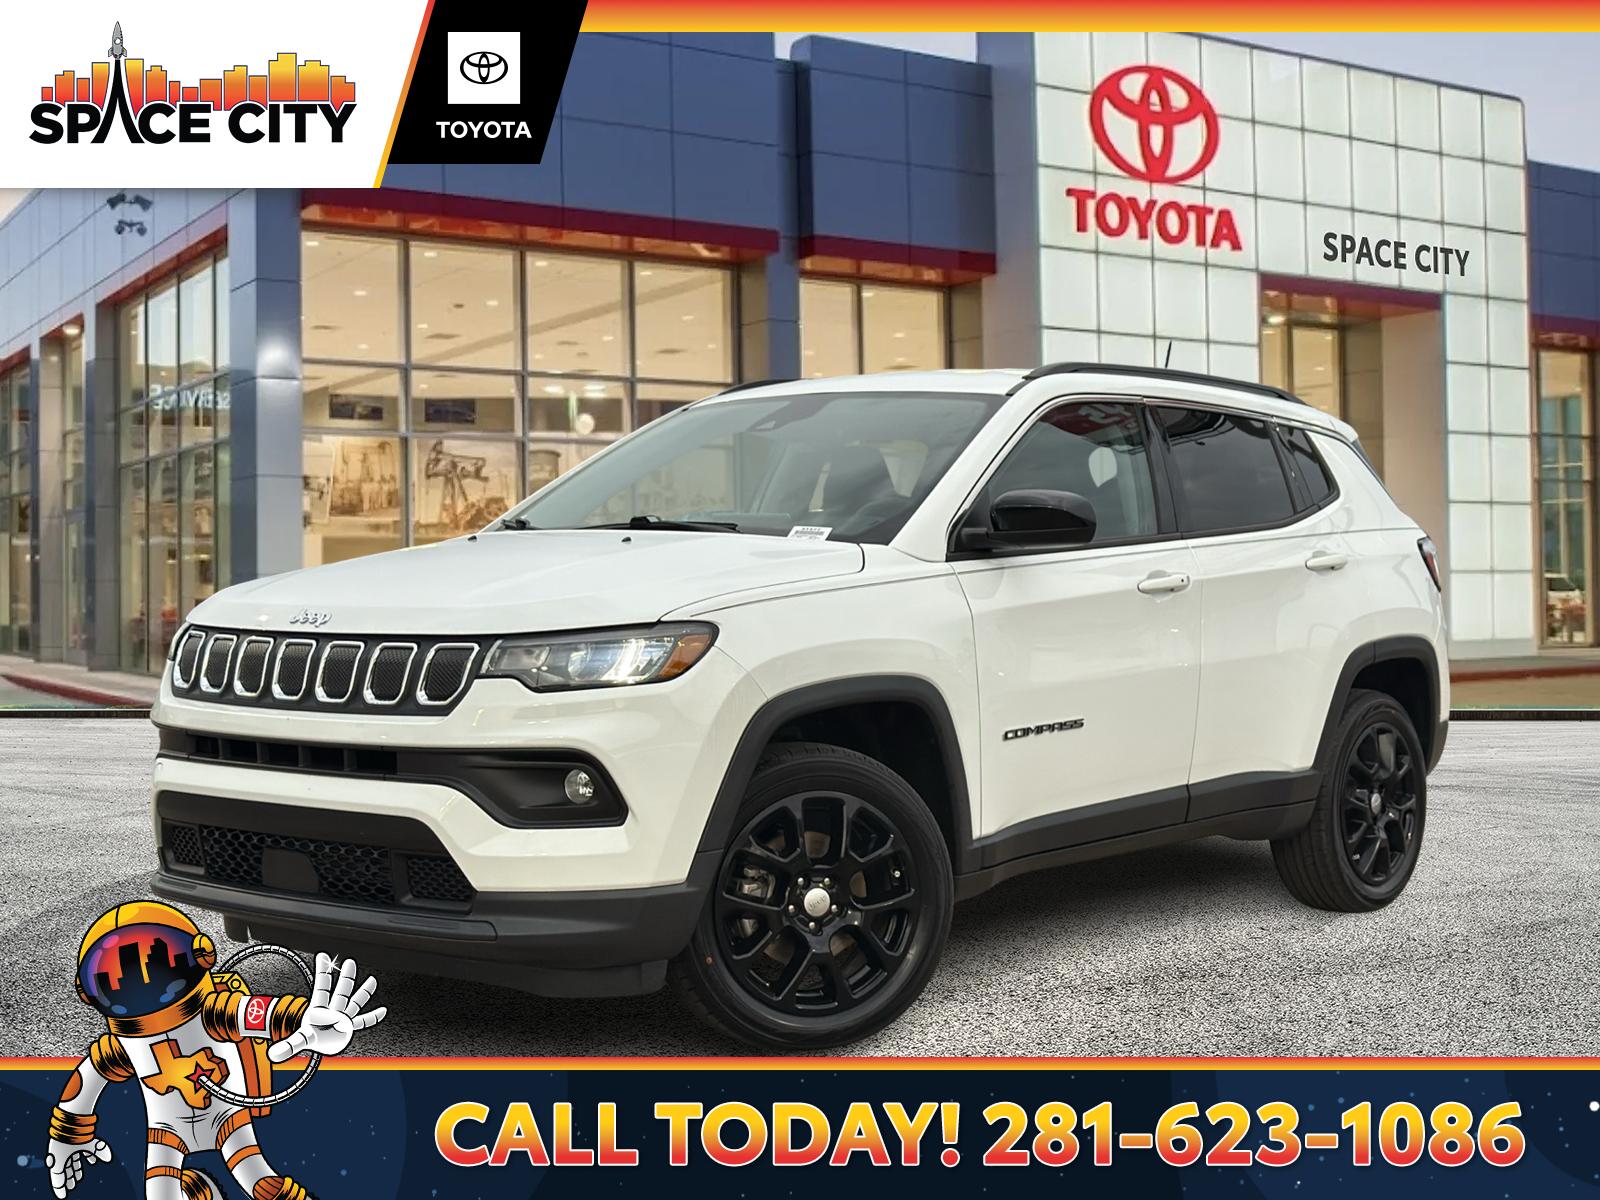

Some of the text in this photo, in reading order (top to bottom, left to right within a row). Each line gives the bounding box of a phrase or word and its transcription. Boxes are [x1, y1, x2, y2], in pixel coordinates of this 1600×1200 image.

[1066, 188, 1243, 251] TOYOTA
[1323, 232, 1471, 277] SPACE CITY
[289, 609, 333, 628] Jeep
[1002, 718, 1085, 741] COMPASS
